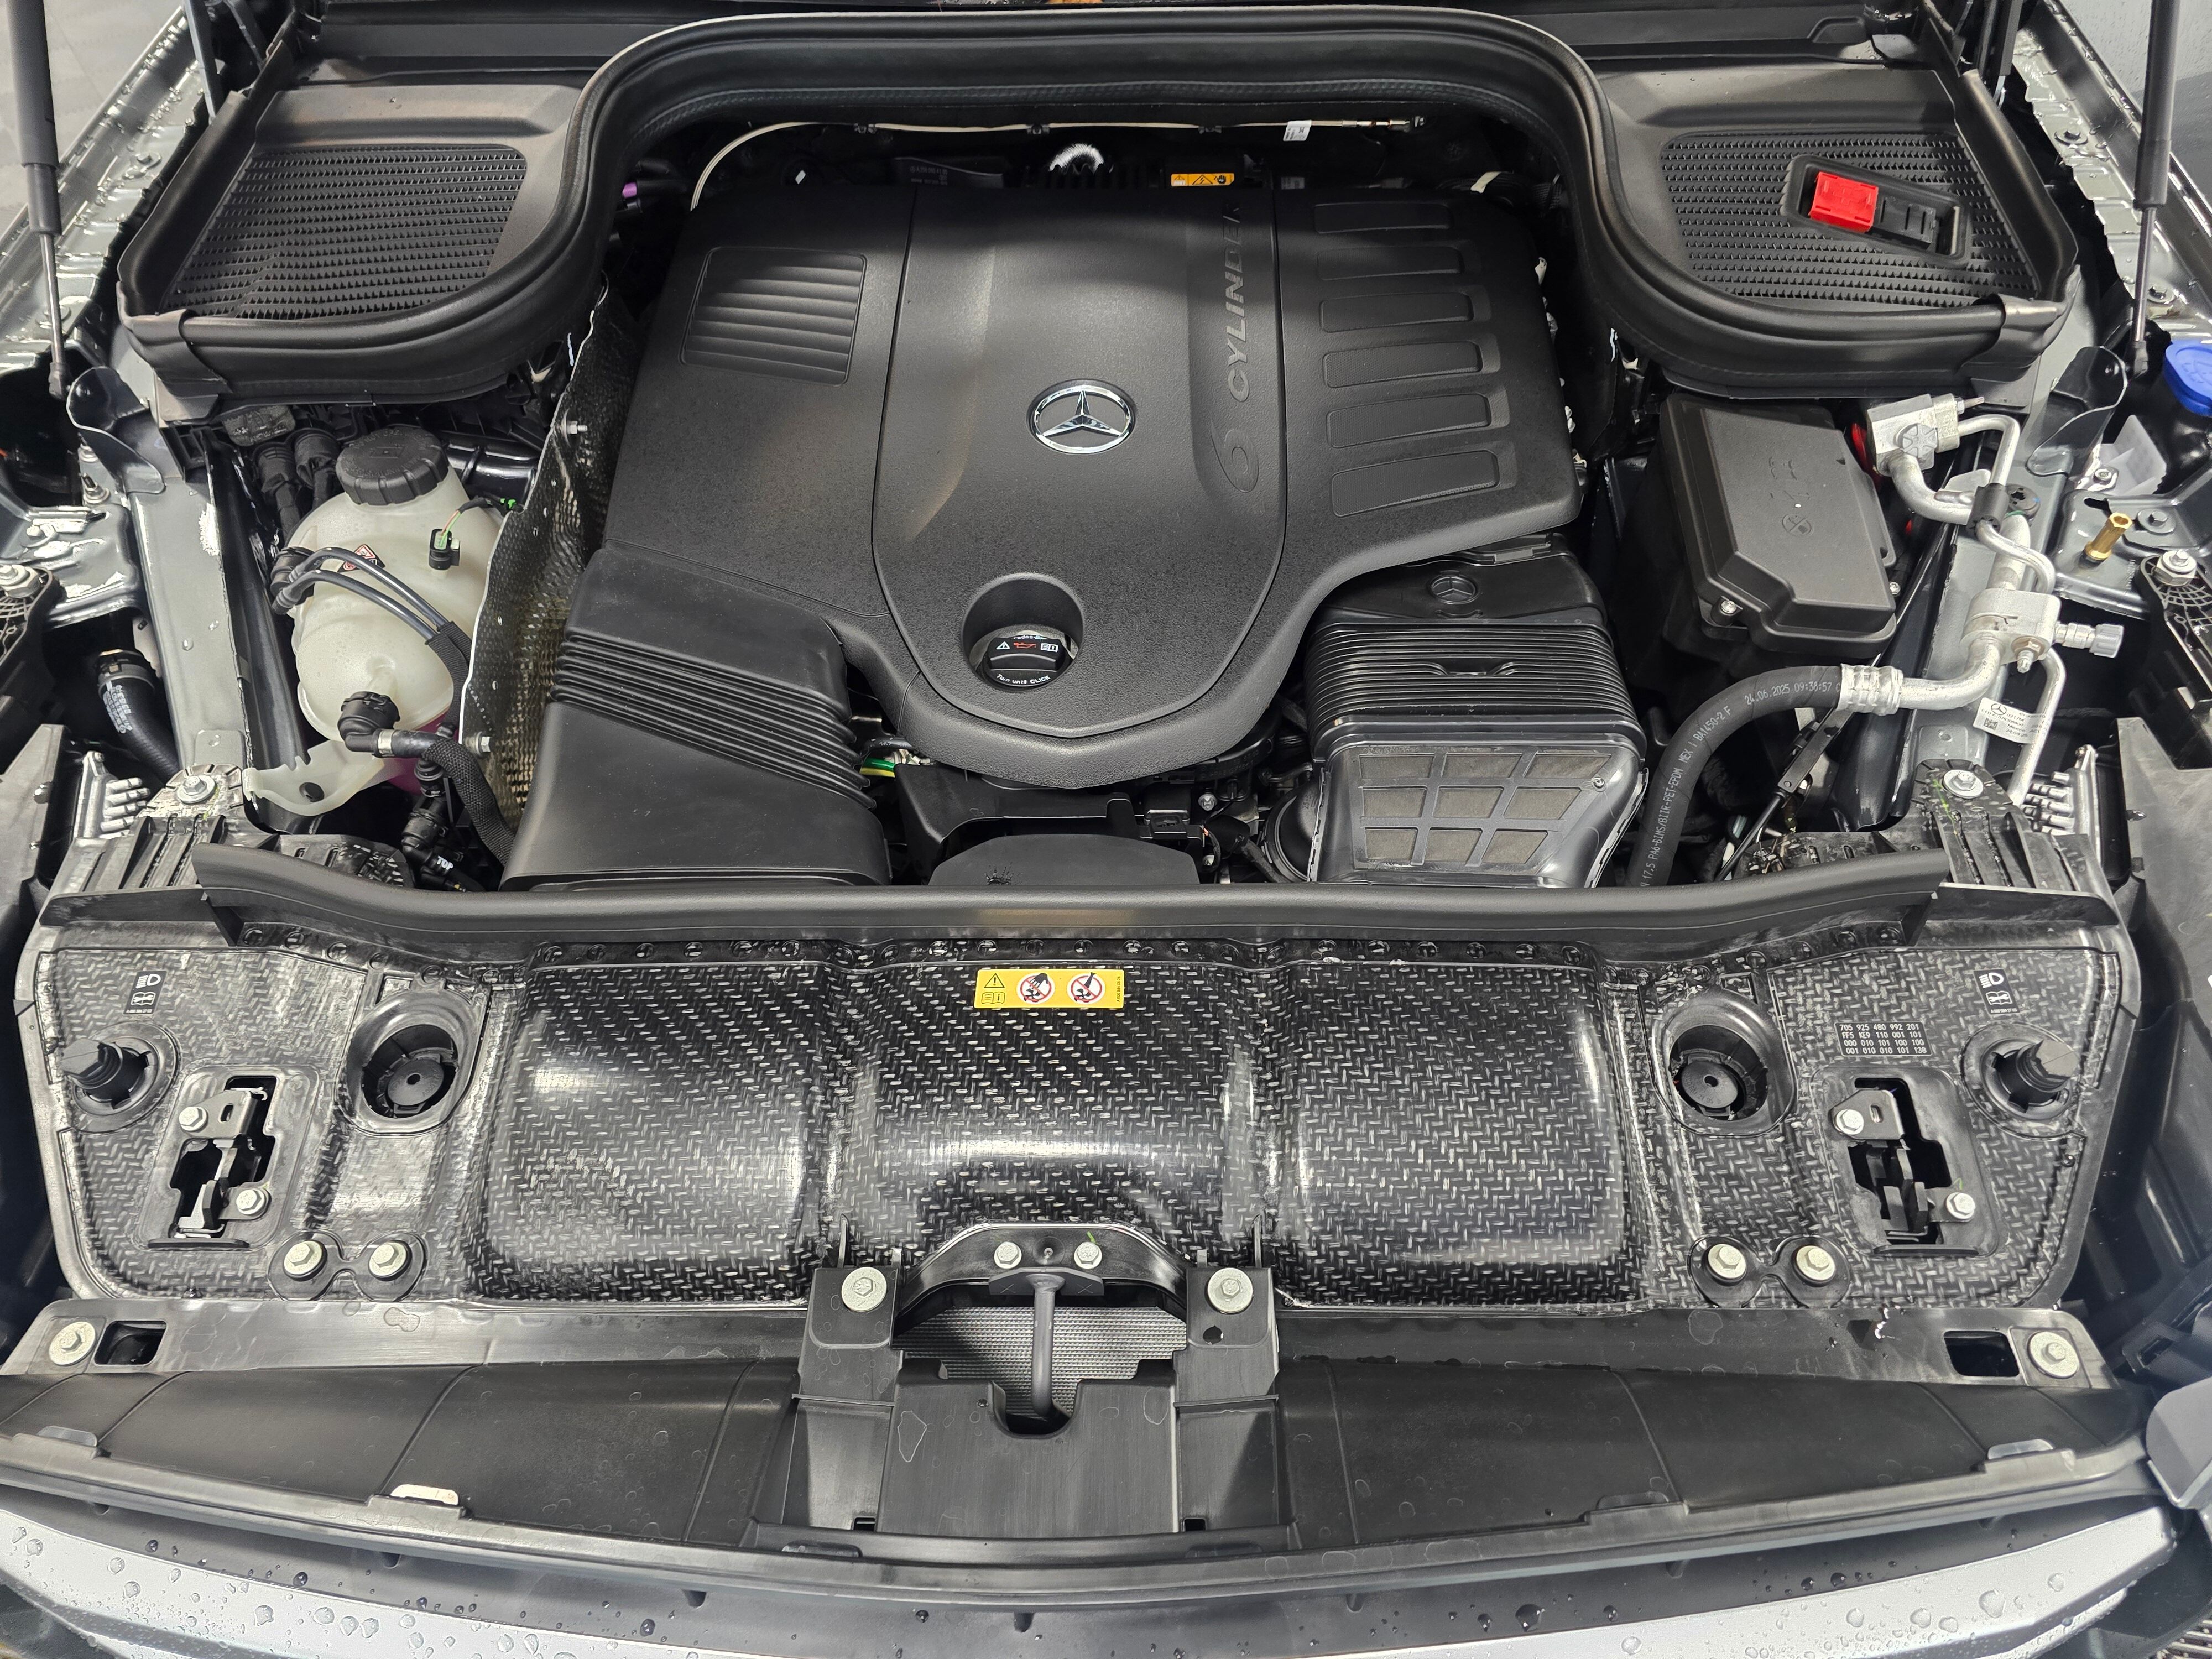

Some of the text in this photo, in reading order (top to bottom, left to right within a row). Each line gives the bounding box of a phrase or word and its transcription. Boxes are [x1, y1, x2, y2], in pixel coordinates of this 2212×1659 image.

[997, 674, 1010, 682] Turn
[1030, 675, 1051, 684] CLICK
[1678, 748, 1693, 764] MEX
[1744, 684, 1790, 705] 24.06.2025
[1794, 681, 1832, 692] 09:38:57
[436, 855, 454, 870] TOP
